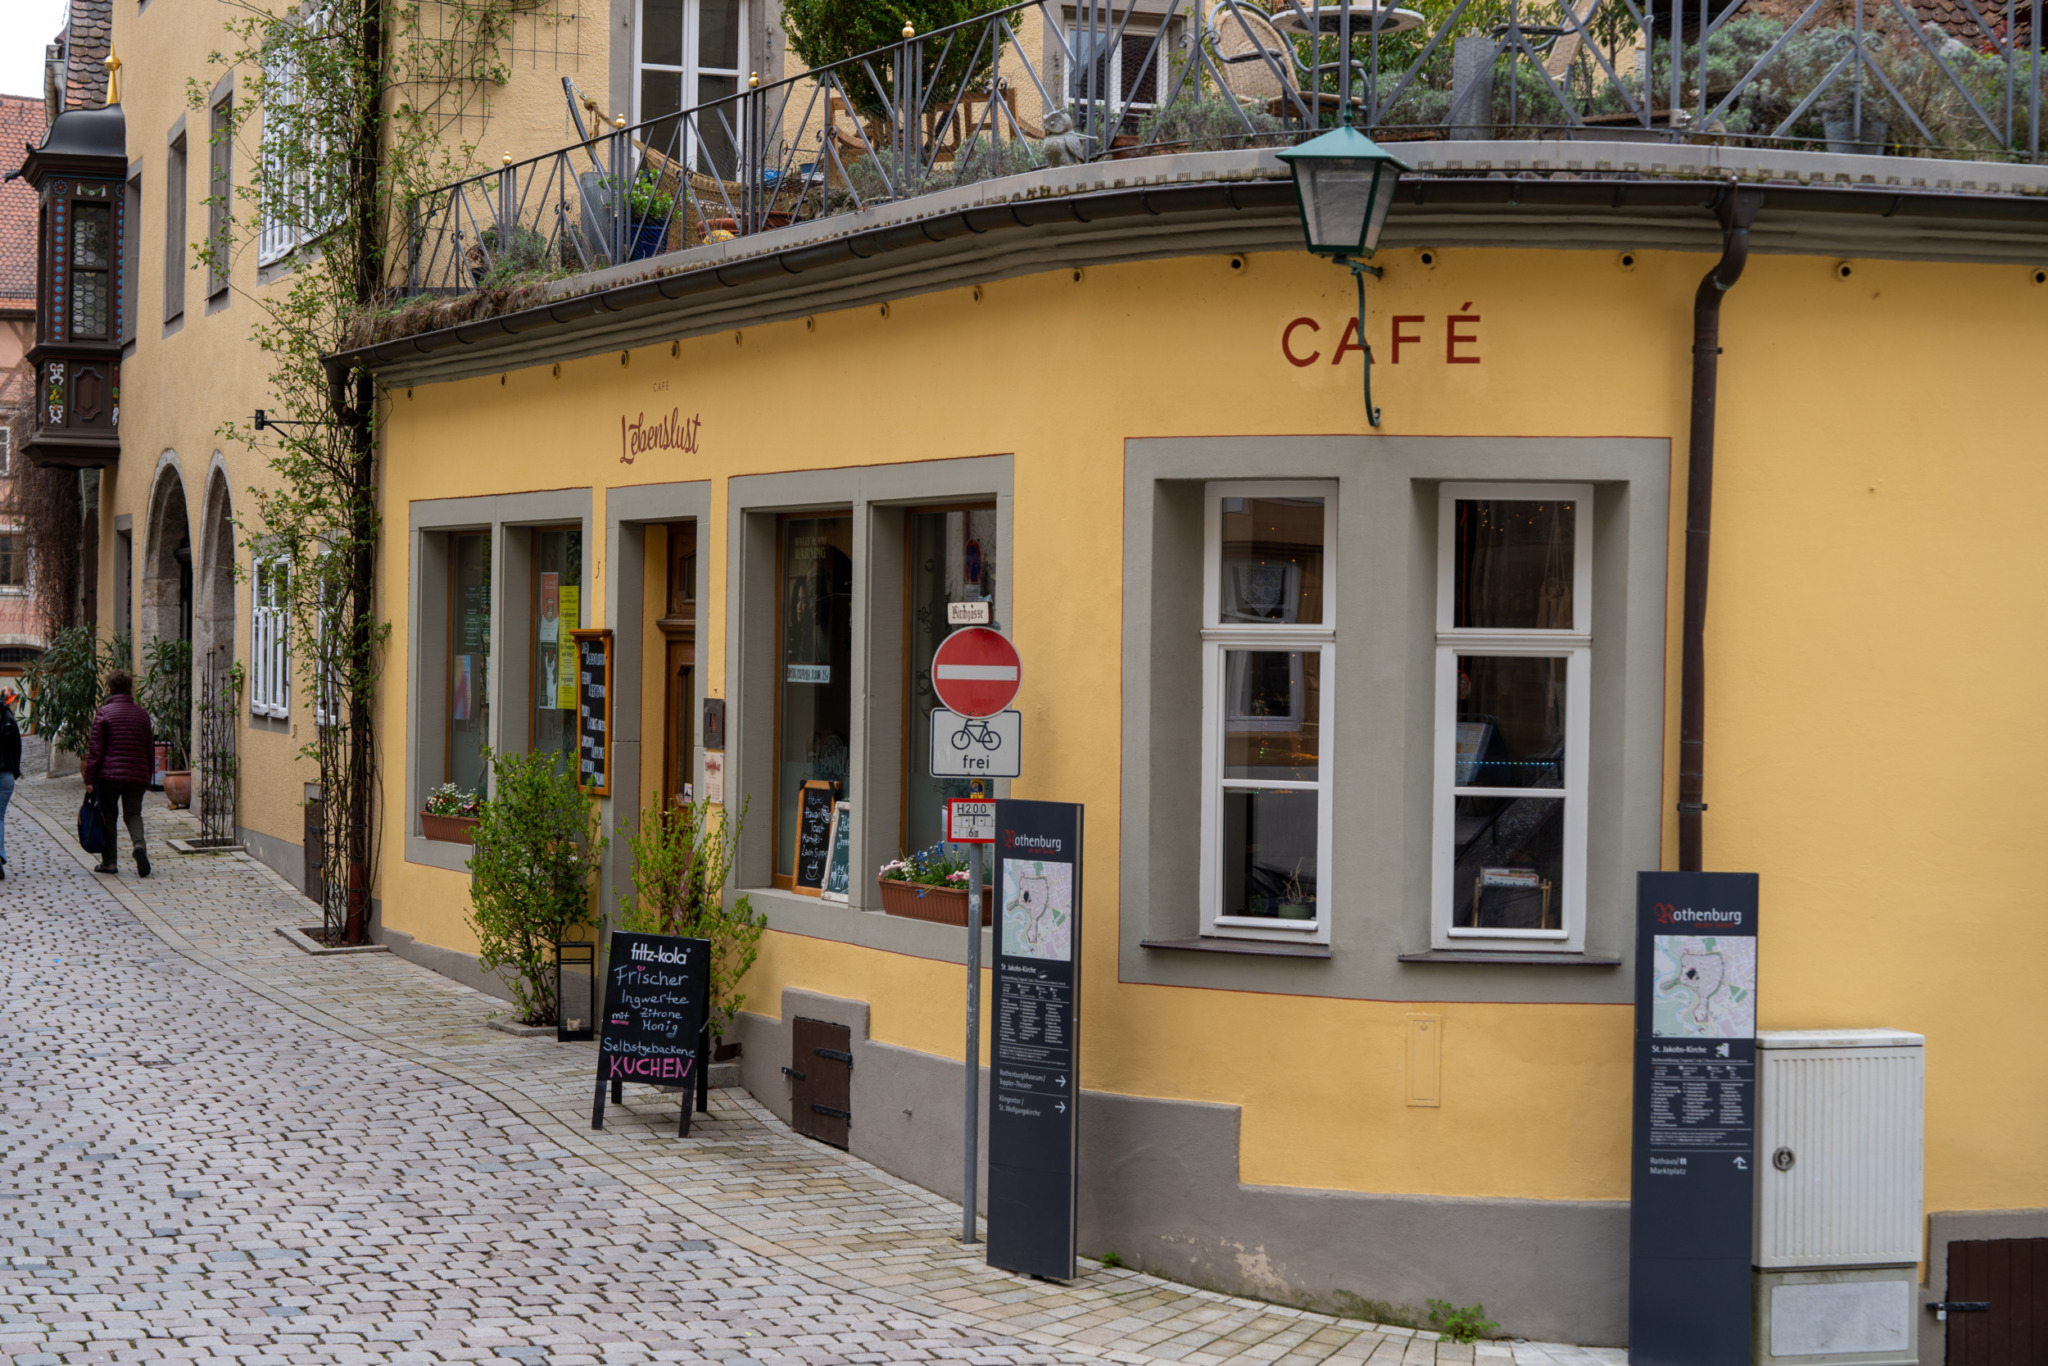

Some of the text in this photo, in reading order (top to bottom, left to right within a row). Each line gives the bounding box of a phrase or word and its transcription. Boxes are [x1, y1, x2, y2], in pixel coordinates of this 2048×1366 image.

[1282, 302, 1480, 367] CAFÉ
[620, 407, 701, 465] Lebenslust
[963, 755, 990, 769] frei
[957, 804, 987, 814] H200
[1004, 829, 1062, 852] Rothenburg
[1654, 903, 1742, 925] Rothenburg
[631, 942, 687, 965] fritz-kola
[613, 965, 688, 986] Frischer
[622, 989, 690, 1009] Ingwertee
[612, 1007, 683, 1020] mit Zitrone
[642, 1019, 678, 1038] Honig
[603, 1037, 696, 1058] Selbstgebackene
[1662, 1045, 1708, 1054] Jakobs-Kirche
[610, 1055, 692, 1078] KUCHEN
[1650, 1167, 1686, 1176] Marktplatz
